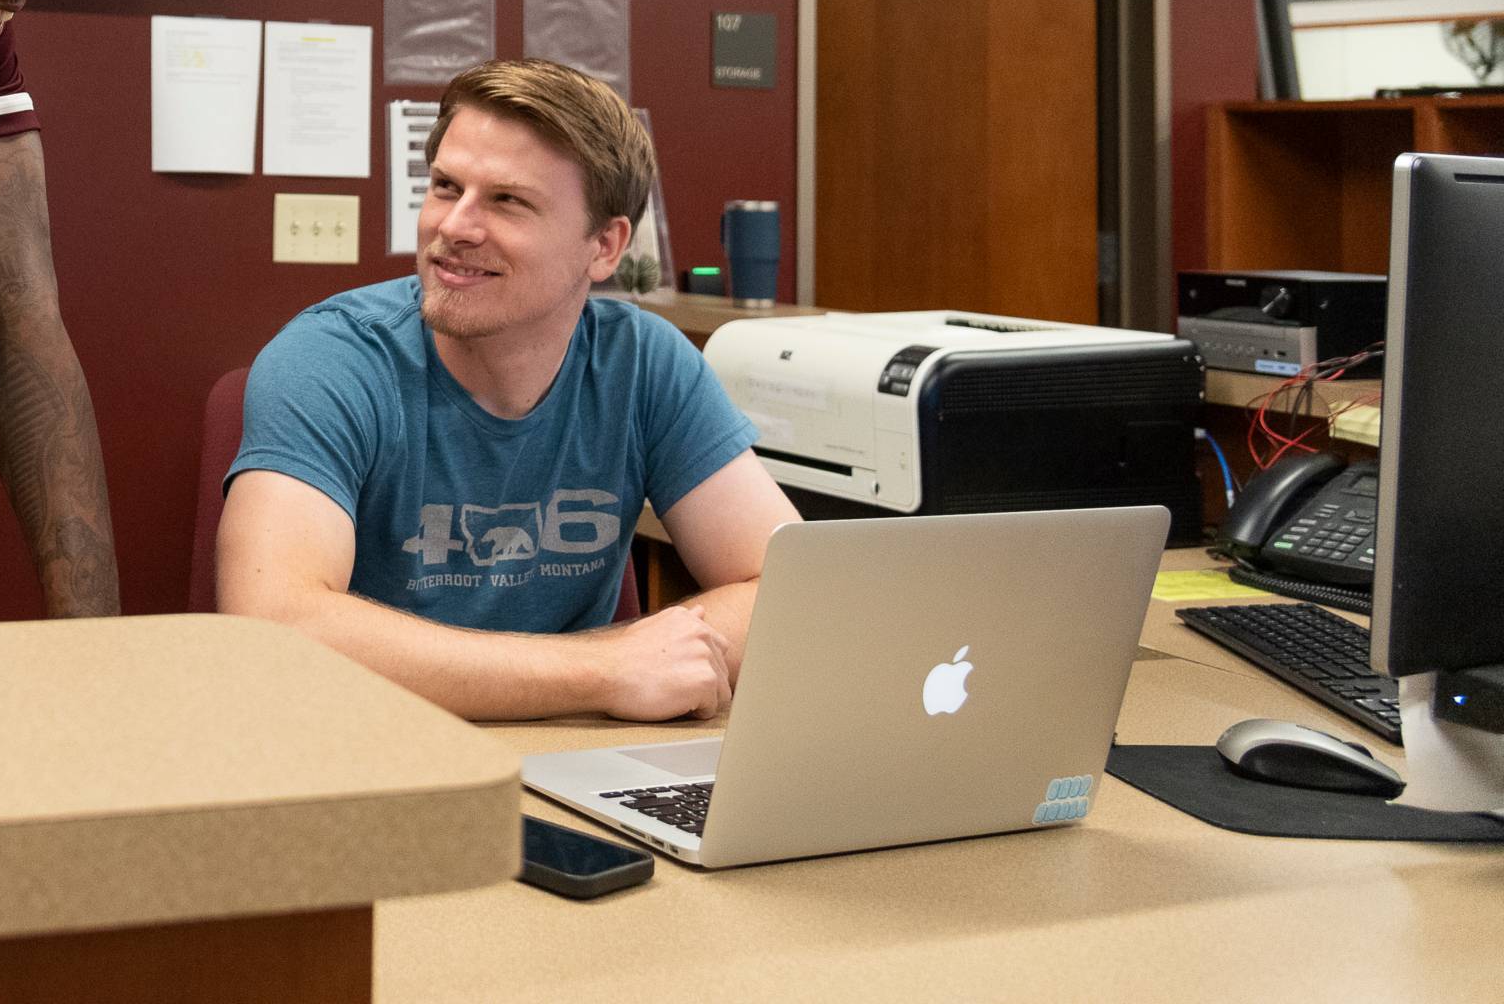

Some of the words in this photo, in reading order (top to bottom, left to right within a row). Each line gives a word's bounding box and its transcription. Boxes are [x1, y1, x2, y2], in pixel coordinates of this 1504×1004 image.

[716, 14, 742, 31] 107
[715, 66, 761, 80] STORAGE
[539, 557, 606, 576] MONTANA
